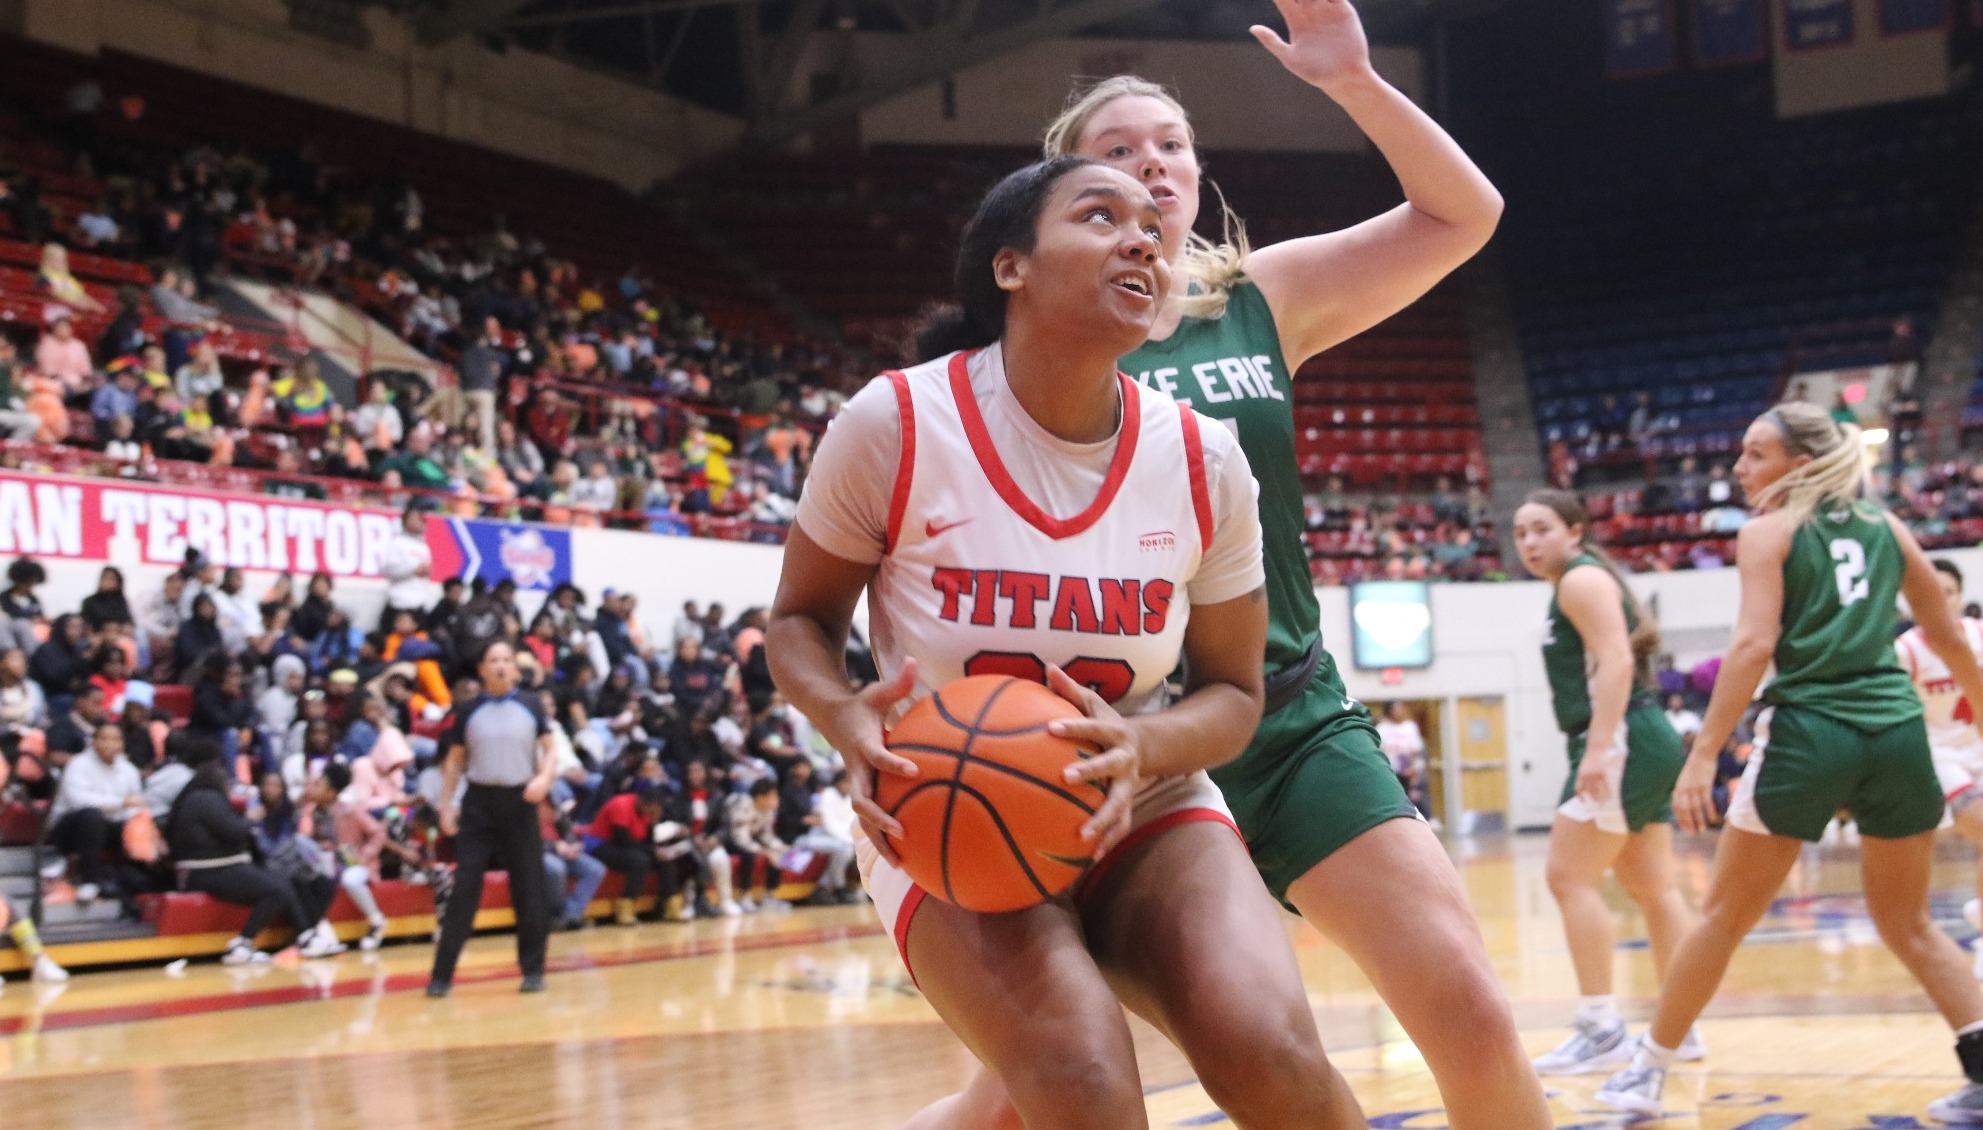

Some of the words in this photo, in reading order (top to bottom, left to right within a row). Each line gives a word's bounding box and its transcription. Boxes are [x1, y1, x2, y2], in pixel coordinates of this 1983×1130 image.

[1191, 354, 1285, 404] ERIE
[101, 489, 402, 576] TERRITOR
[931, 566, 1175, 636] TITANS
[1829, 538, 1869, 606] 2
